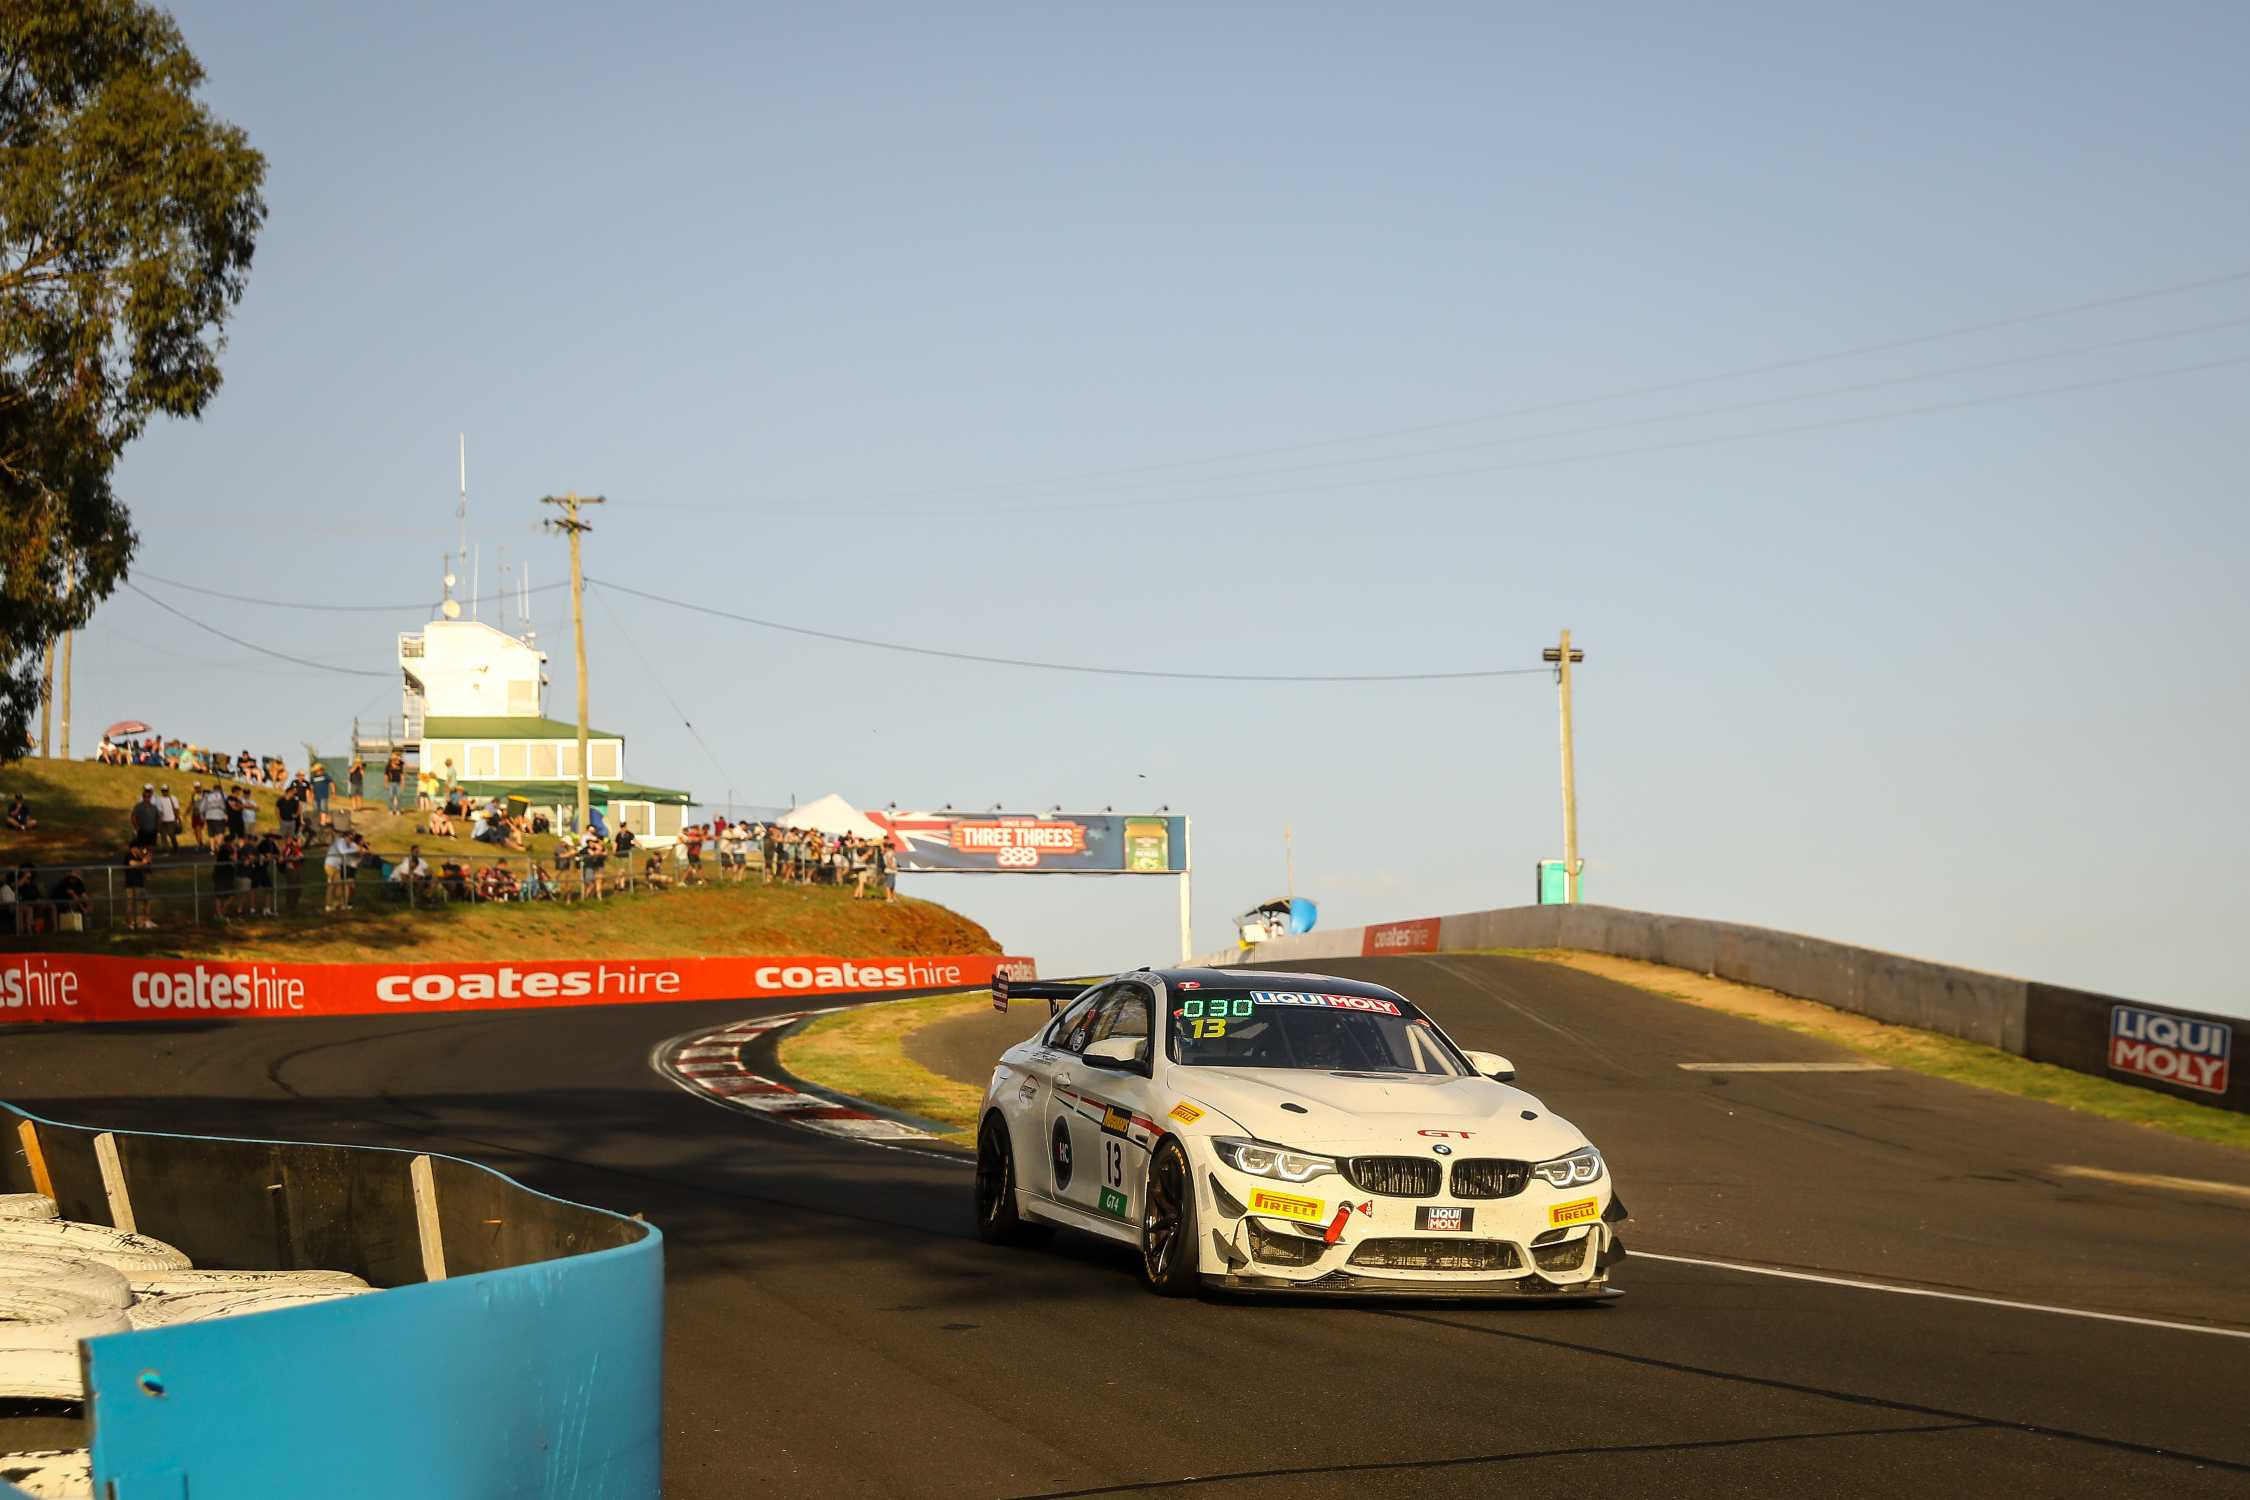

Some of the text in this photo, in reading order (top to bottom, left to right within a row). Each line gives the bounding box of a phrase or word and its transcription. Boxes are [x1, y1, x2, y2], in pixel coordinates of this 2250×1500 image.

[963, 828, 1073, 847] THREE THREES
[1254, 992, 1392, 1013] LIQUI MOLY
[1191, 1018, 1227, 1039] 13
[2117, 1010, 2223, 1056] LIQUI
[2115, 1040, 2223, 1086] MOLY
[1417, 1129, 1477, 1139] GT
[1106, 1140, 1122, 1188] 13
[1106, 1194, 1120, 1211] GT4
[1255, 1193, 1318, 1217] PIRELLI
[1553, 1202, 1595, 1222] PIRELLI
[1430, 1208, 1460, 1219] LIQUI
[1429, 1219, 1460, 1230] MOLY
